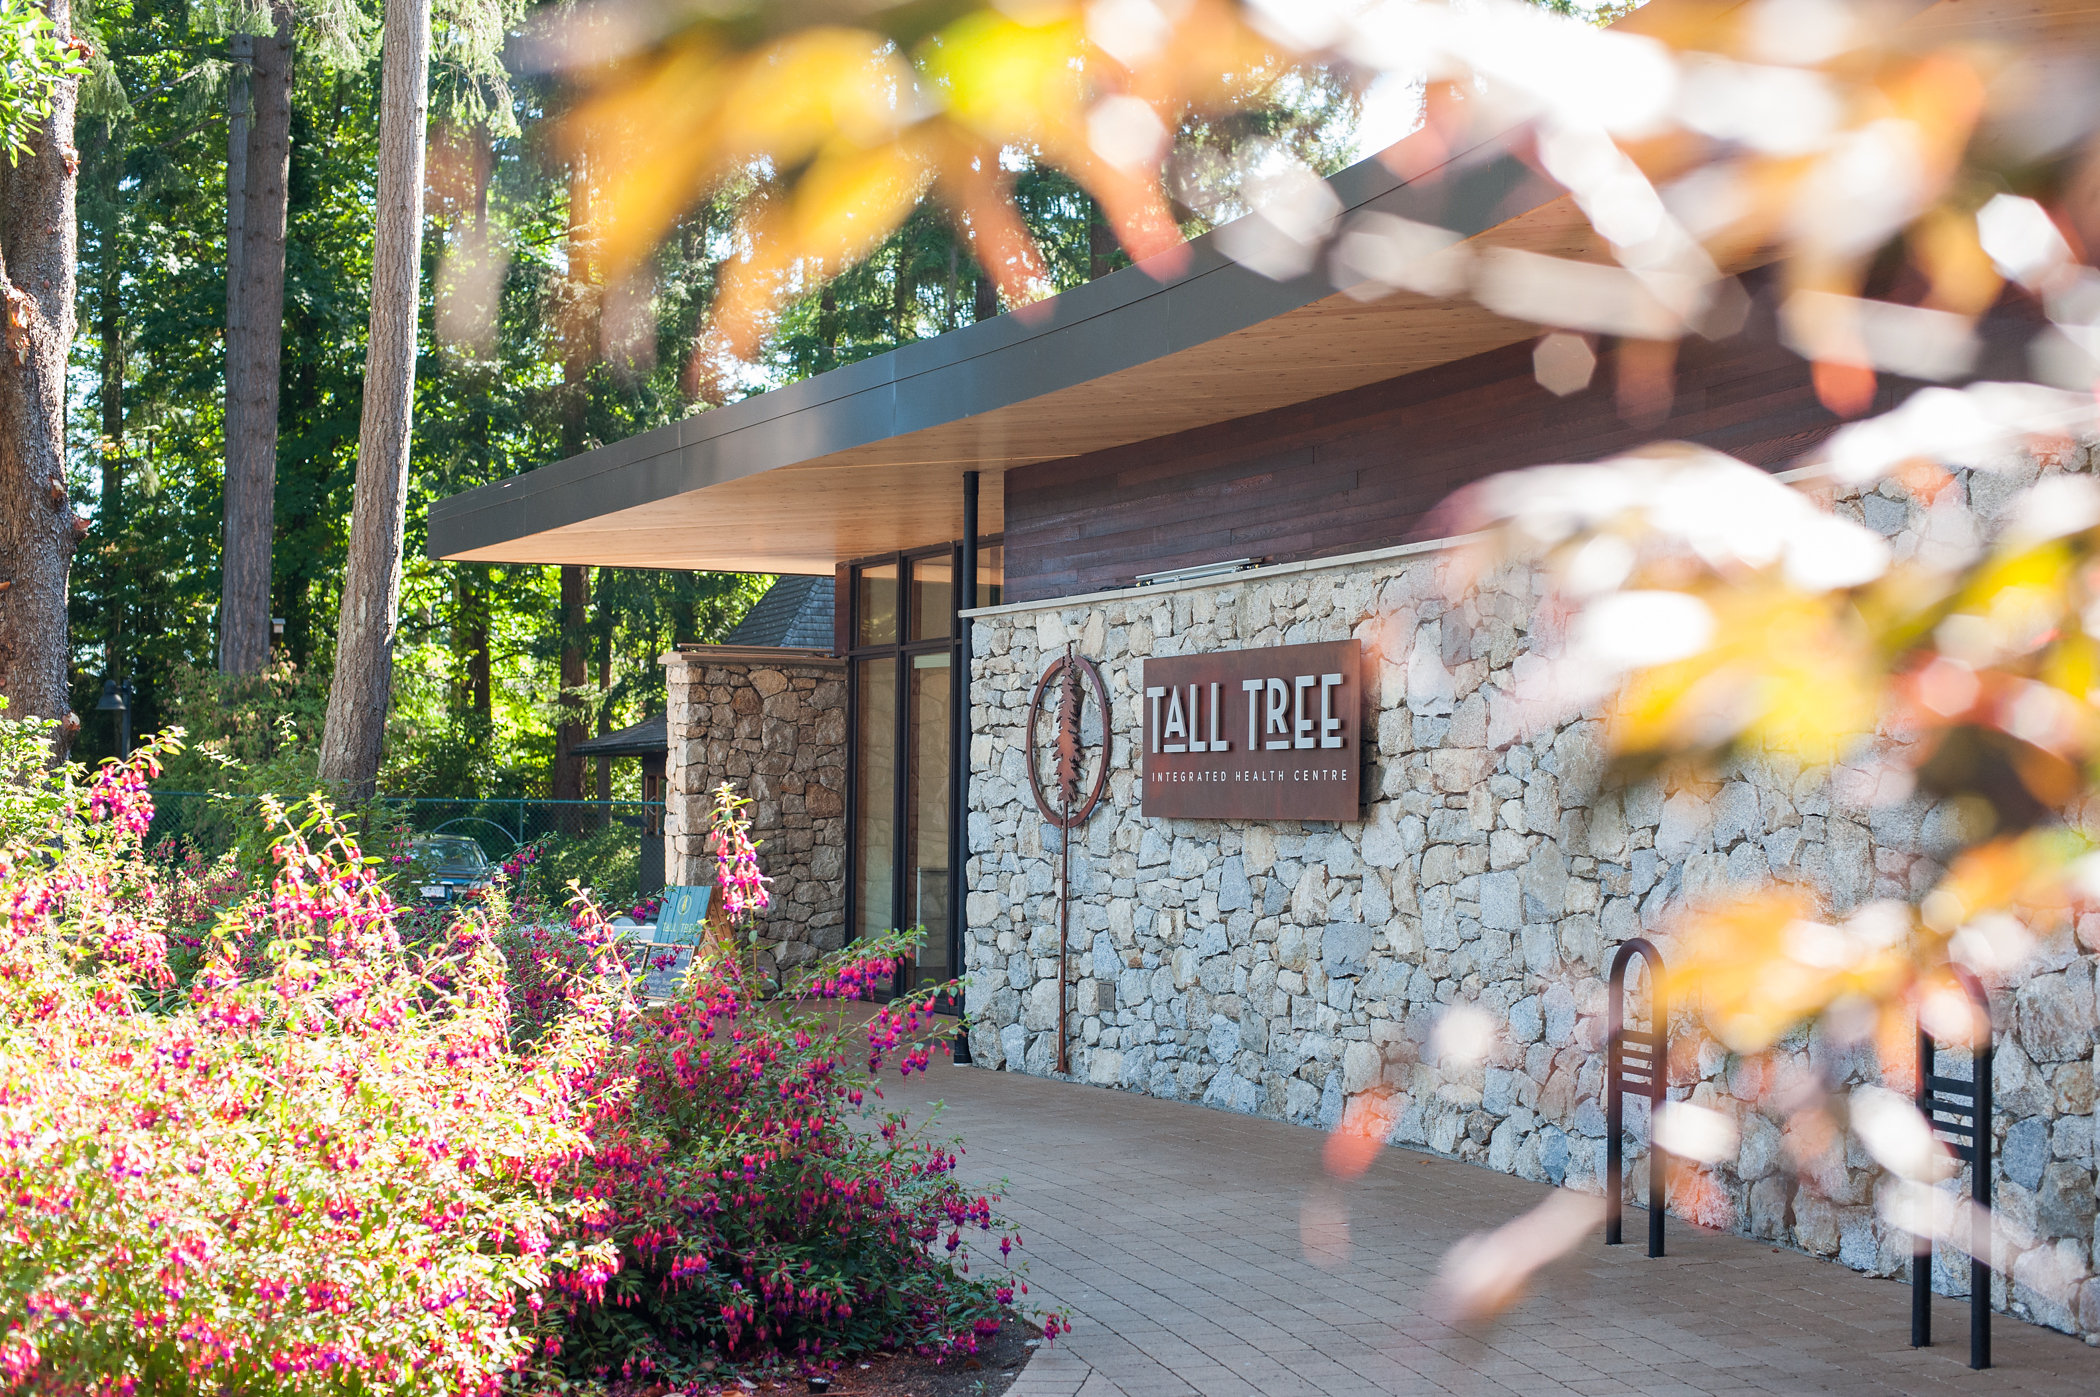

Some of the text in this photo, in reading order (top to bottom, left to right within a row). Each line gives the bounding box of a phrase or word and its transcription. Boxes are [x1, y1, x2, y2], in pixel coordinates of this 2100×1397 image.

[1146, 673, 1344, 754] TALL TREE
[1151, 769, 1348, 783] INTEGRATED HEALTH CENTRE
